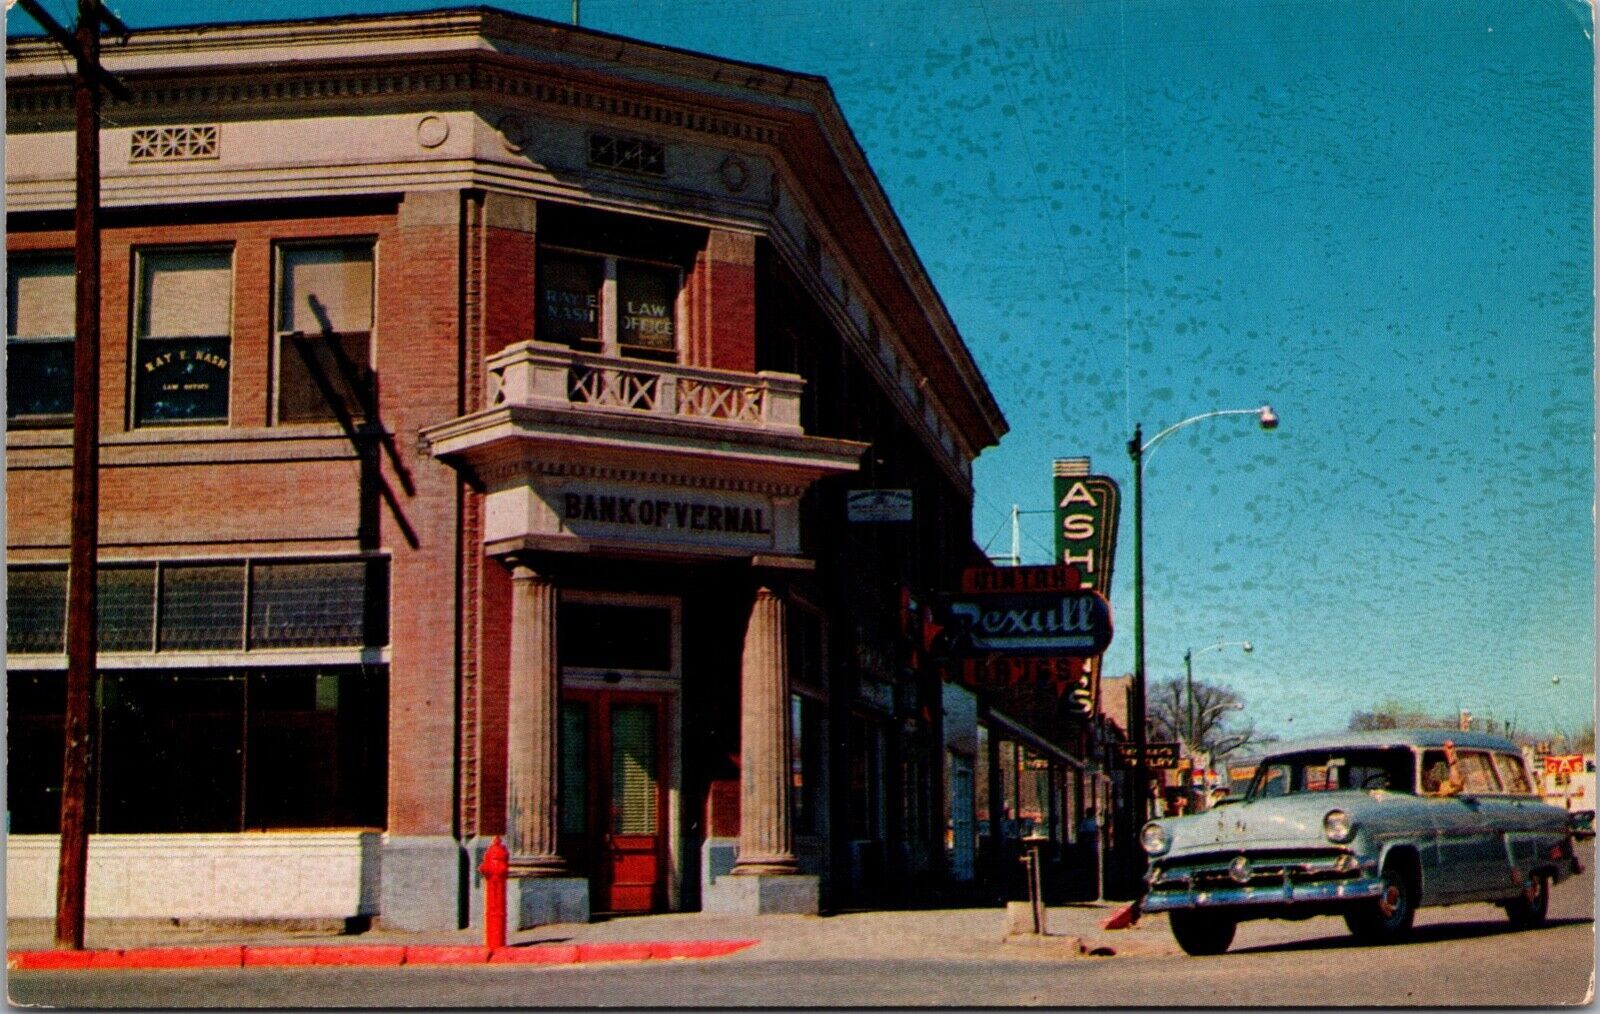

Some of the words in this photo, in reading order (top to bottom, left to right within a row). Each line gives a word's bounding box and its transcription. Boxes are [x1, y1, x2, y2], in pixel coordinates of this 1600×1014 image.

[627, 300, 666, 317] LAW
[144, 352, 172, 373] RAY
[195, 350, 228, 370] NASH
[162, 383, 179, 391] LAW
[183, 383, 209, 391] OFFICE
[565, 493, 638, 524] BANK
[639, 498, 673, 527] OF
[676, 502, 771, 534] VERNAL
